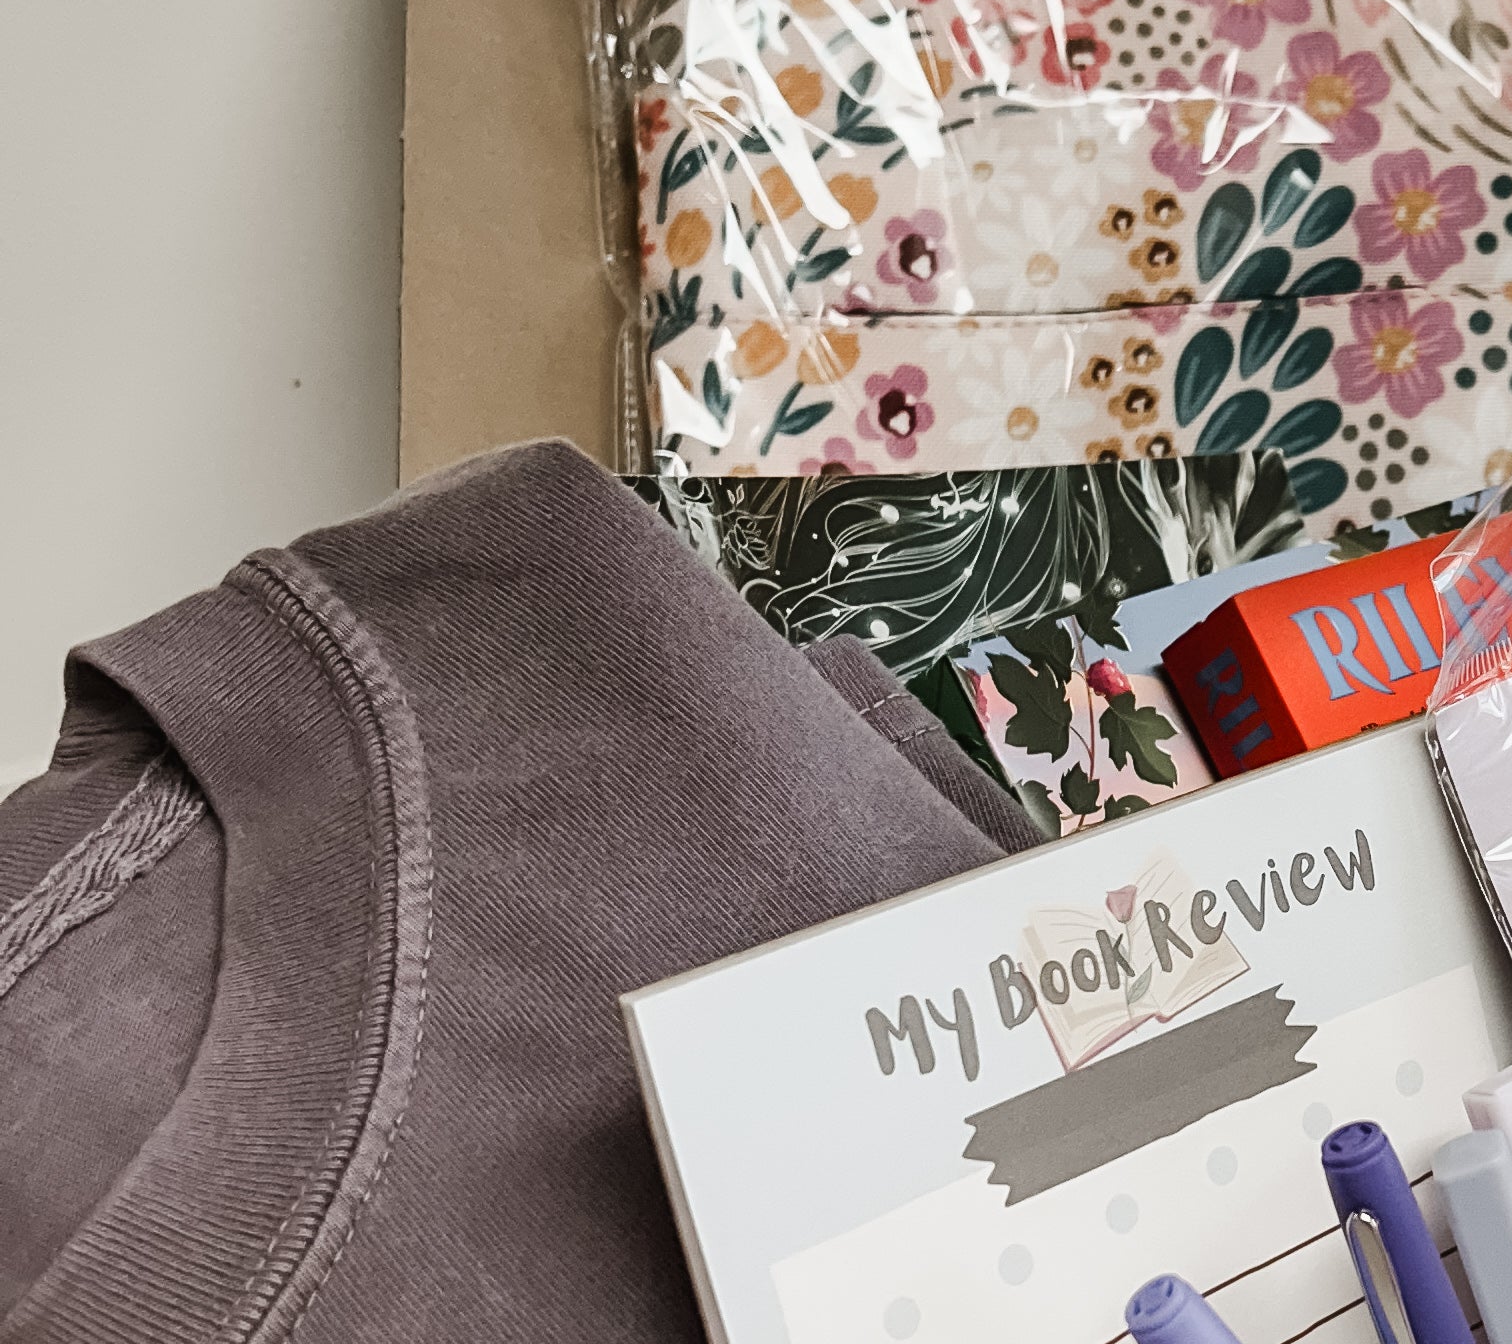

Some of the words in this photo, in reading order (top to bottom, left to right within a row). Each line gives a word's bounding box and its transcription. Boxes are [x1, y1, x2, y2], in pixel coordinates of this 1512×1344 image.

[865, 987, 979, 1083] My
[988, 929, 1137, 1030] Book
[1145, 829, 1376, 974] Review
